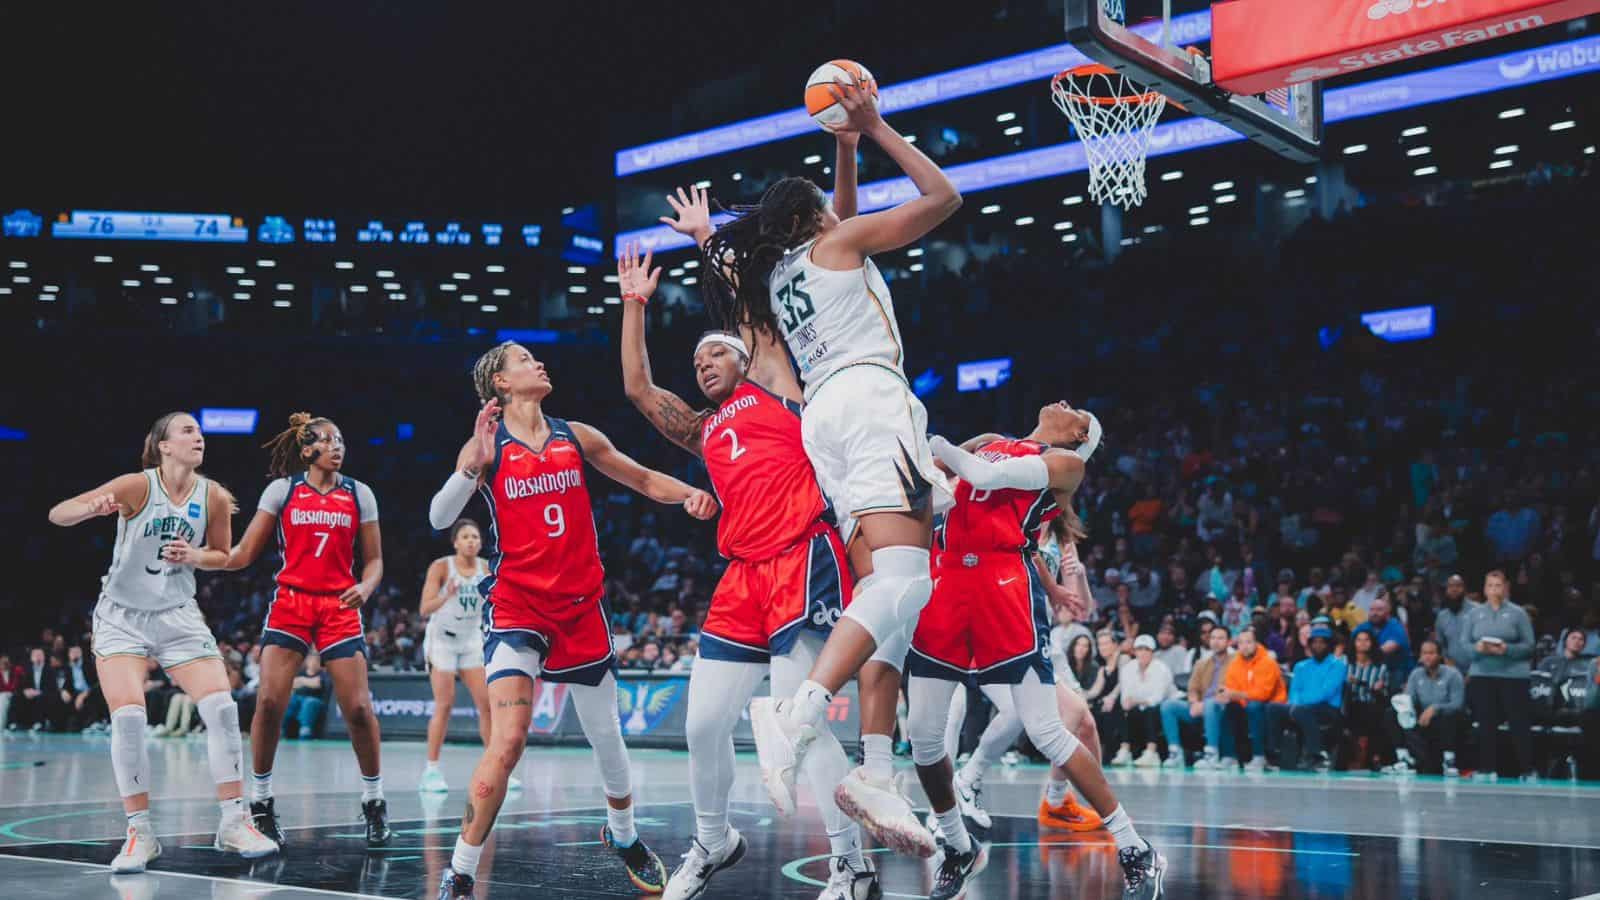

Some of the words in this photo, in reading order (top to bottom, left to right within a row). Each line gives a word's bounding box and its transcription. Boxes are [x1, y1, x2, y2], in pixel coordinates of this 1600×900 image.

[88, 215, 115, 234] 76
[194, 219, 219, 236] 74
[776, 270, 816, 334] 35
[720, 427, 747, 461] 2
[504, 468, 581, 500] Washington
[290, 507, 352, 529] Washington
[543, 503, 566, 538] 9
[313, 531, 329, 558] 7
[459, 596, 478, 612] 44
